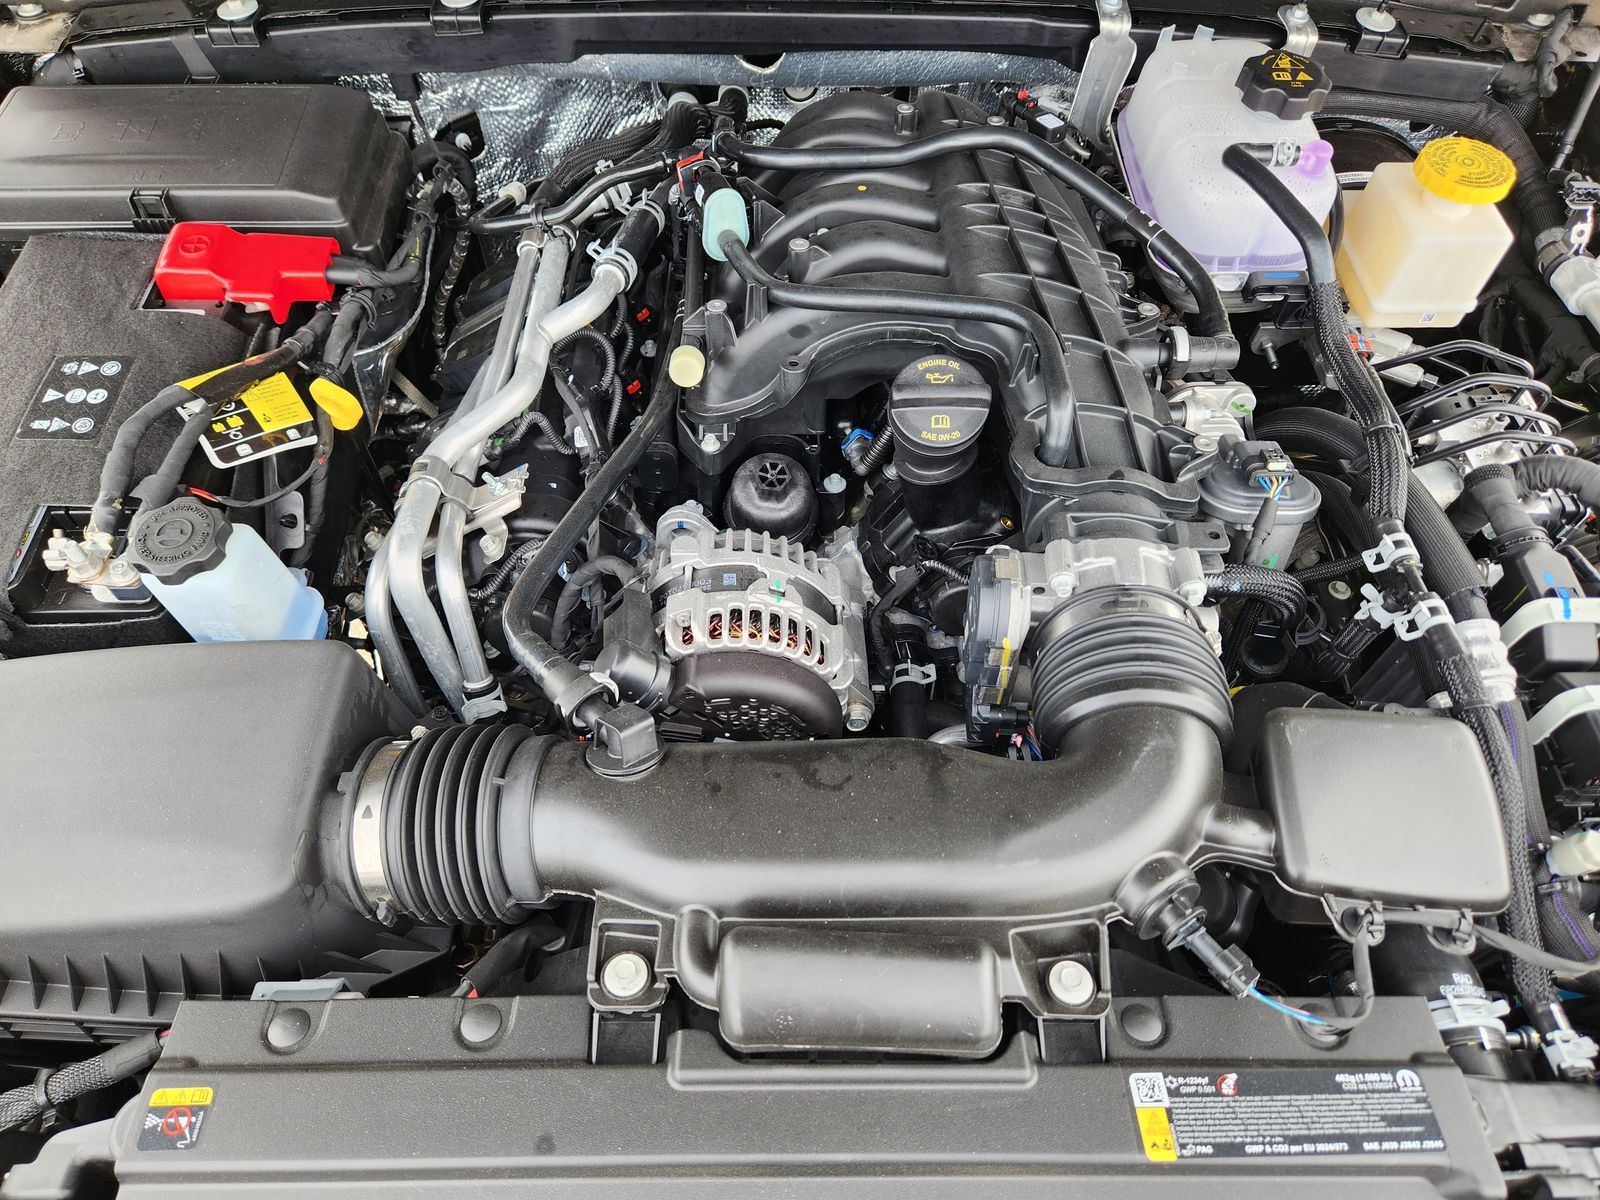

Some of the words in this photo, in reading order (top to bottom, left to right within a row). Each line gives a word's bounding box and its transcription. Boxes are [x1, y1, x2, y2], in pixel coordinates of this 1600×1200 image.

[917, 359, 946, 370] ENGINE
[948, 360, 961, 370] OIL
[921, 431, 937, 440] SAE
[938, 431, 961, 440] 0W-20
[168, 504, 208, 519] APPROVED
[137, 531, 151, 557] POWER
[150, 550, 191, 561] STEERING
[1452, 972, 1473, 984] RAD
